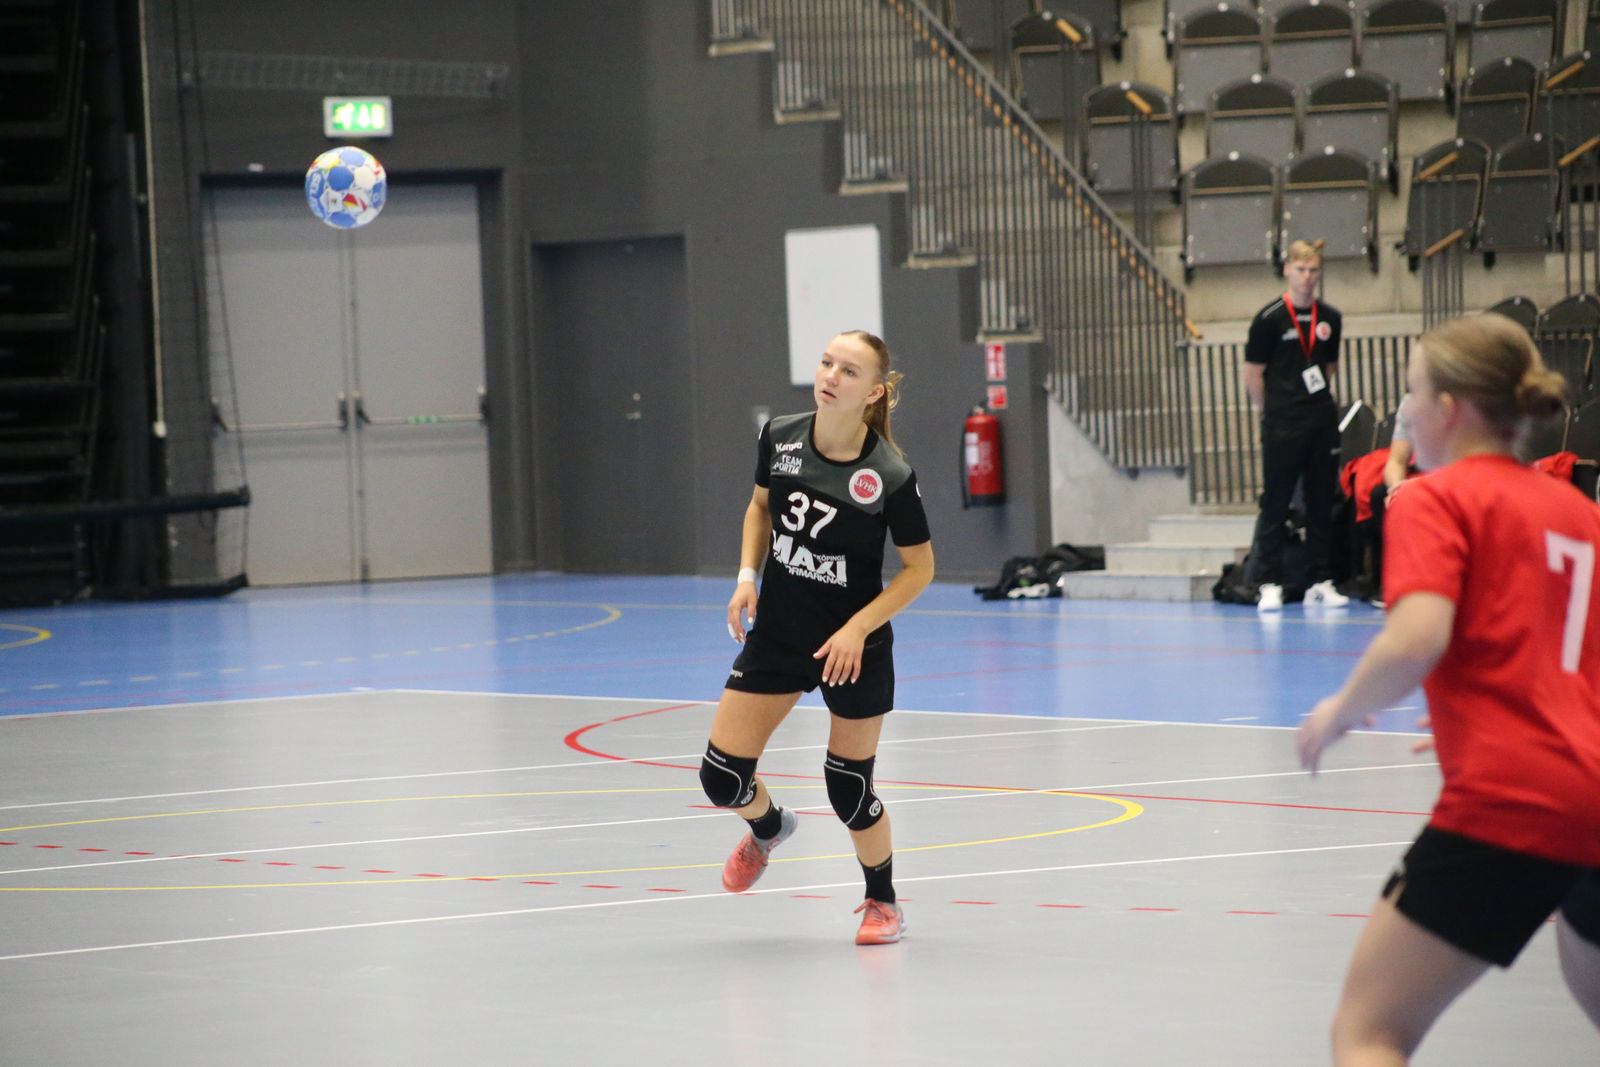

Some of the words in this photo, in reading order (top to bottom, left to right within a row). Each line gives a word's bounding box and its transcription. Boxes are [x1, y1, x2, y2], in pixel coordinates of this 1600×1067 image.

[772, 462, 800, 474] PORTIA
[782, 454, 803, 467] TEAM
[780, 491, 838, 539] 37
[772, 529, 848, 583] MAXI
[813, 553, 846, 563] KÖPINGE
[1545, 529, 1596, 675] 7
